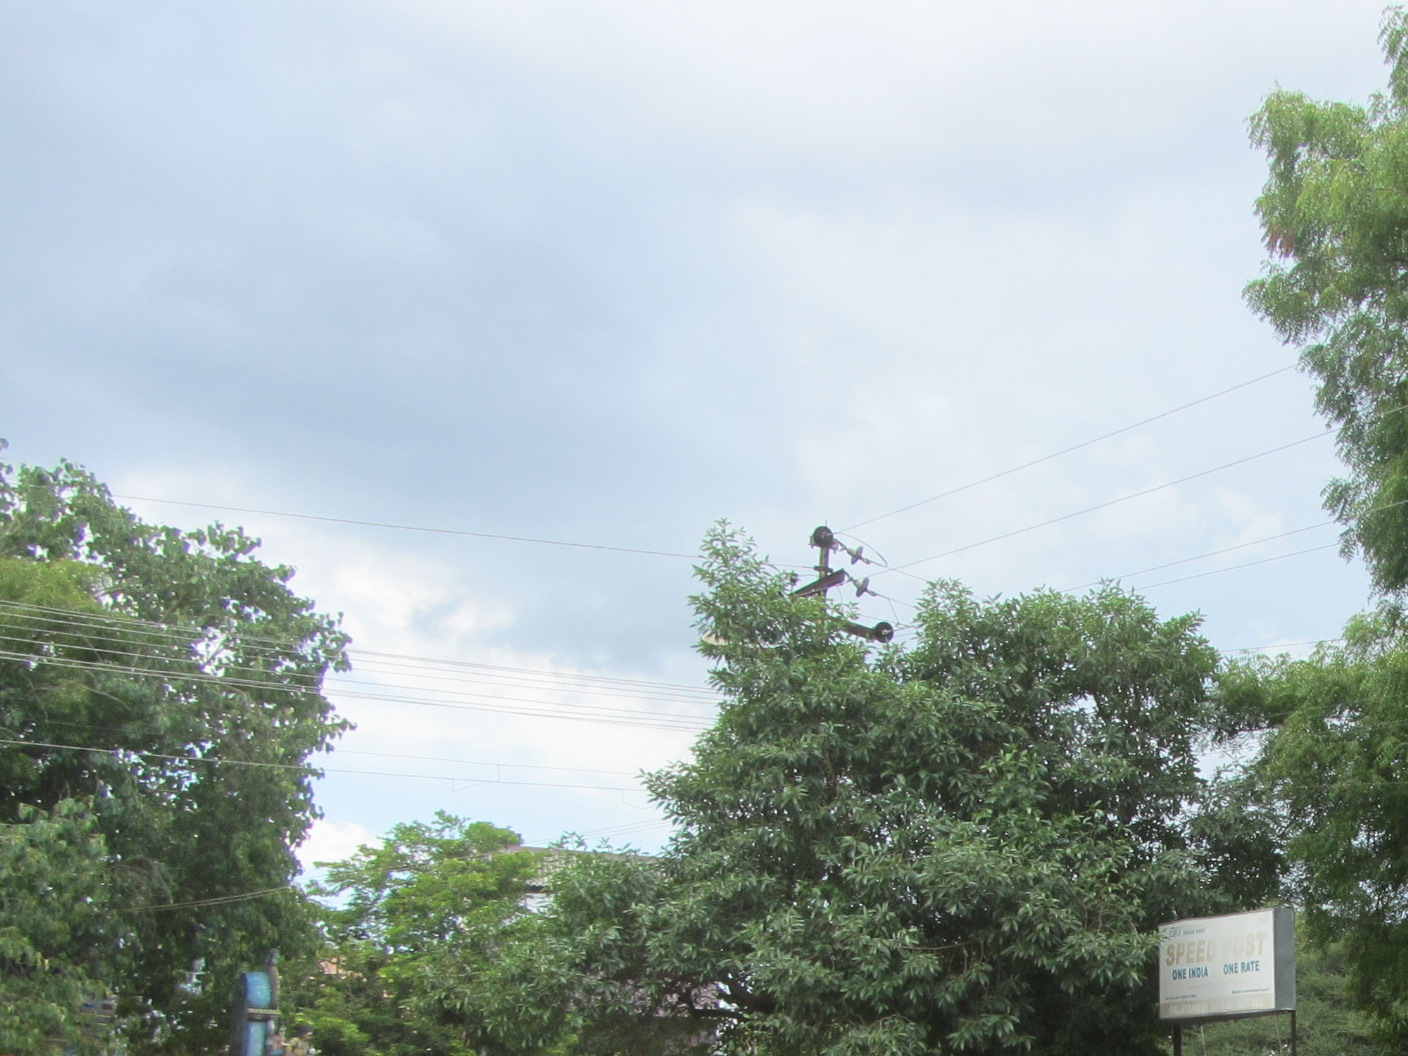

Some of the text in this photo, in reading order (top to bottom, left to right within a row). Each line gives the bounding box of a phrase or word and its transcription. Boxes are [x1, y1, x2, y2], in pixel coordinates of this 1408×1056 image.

[1165, 940, 1215, 967] SPEED
[1172, 960, 1260, 980] ONE INDIA ONE RATE
